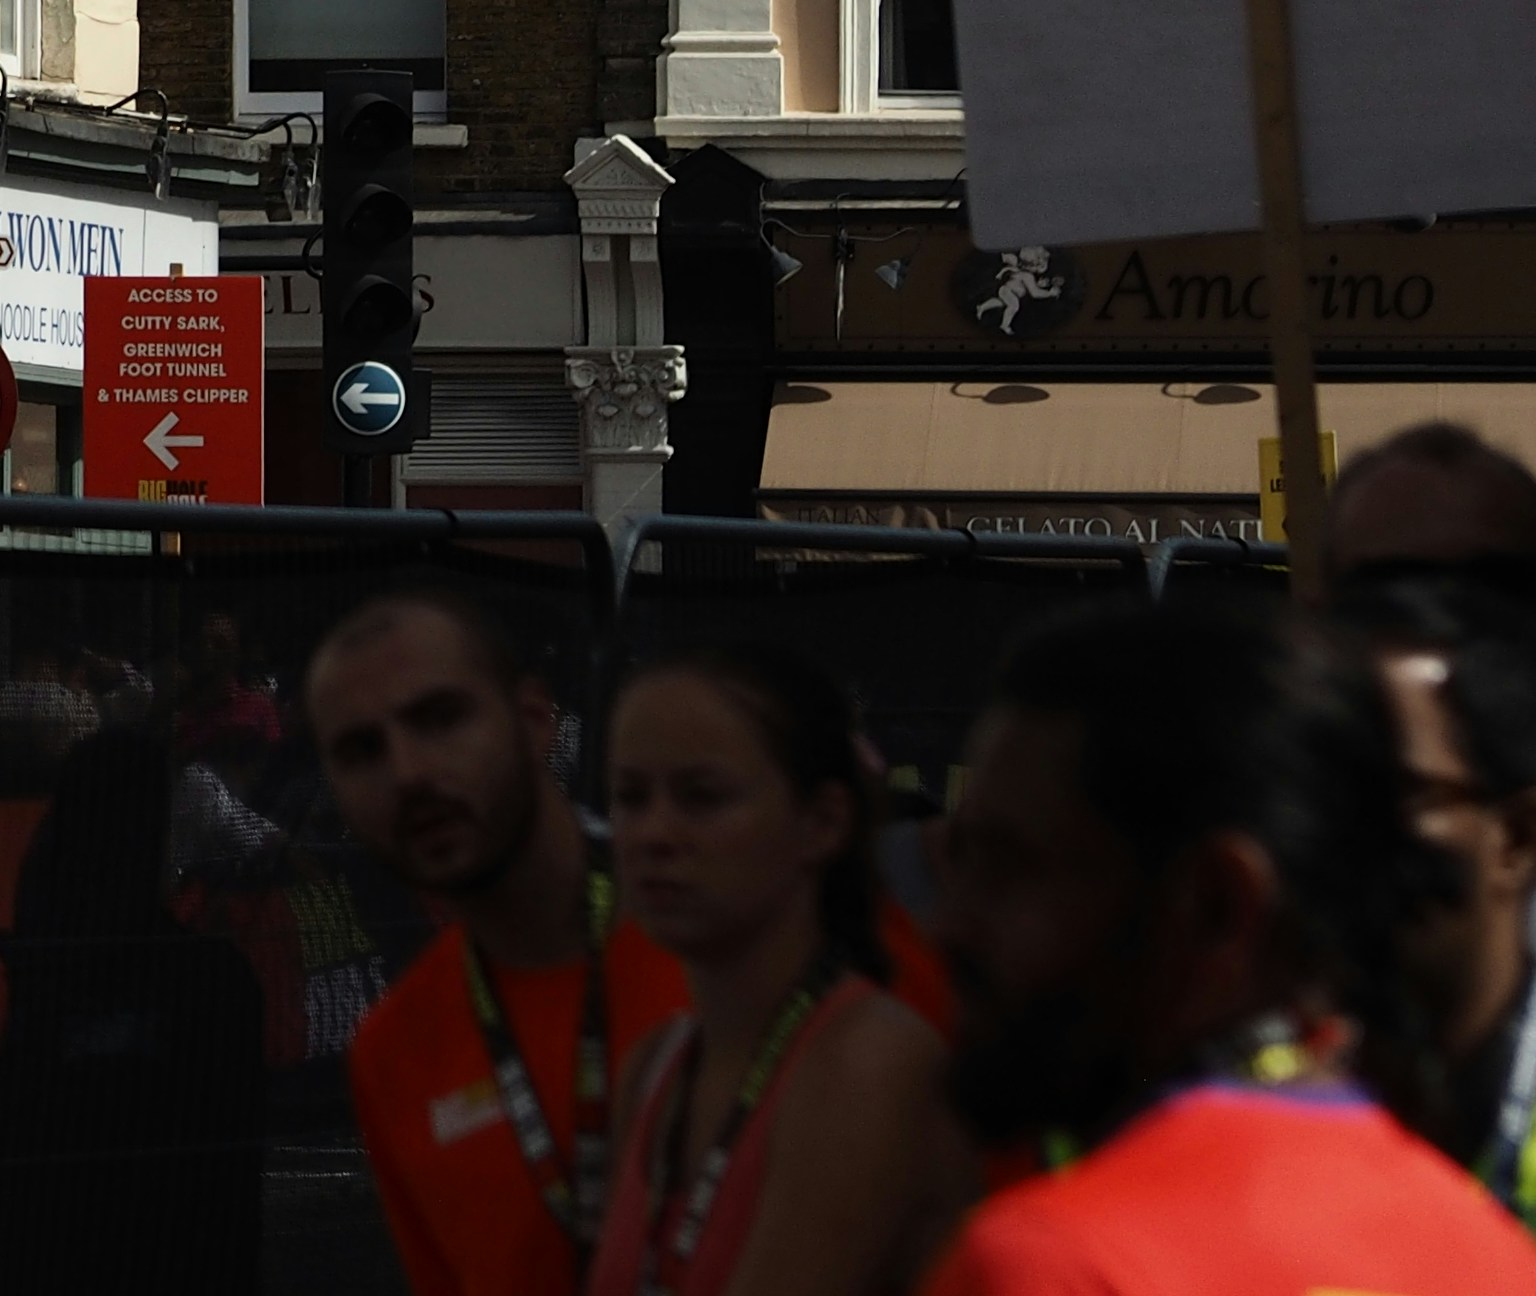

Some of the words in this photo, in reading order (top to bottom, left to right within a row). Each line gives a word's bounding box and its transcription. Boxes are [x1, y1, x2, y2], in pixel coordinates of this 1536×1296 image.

[66, 219, 125, 277] MEIN
[1094, 250, 1434, 320] Amoino
[128, 289, 192, 303] ACCESS
[196, 289, 218, 303] TO
[51, 308, 85, 348] HOUS
[121, 316, 172, 330] CUTTY
[177, 316, 225, 333] SARK,
[123, 343, 222, 358] GREENWICH
[119, 363, 163, 377] FOOT
[166, 363, 227, 377] TUNNEL
[97, 388, 109, 402] &
[114, 388, 178, 403] THAMES
[183, 389, 249, 403] CLIPPER
